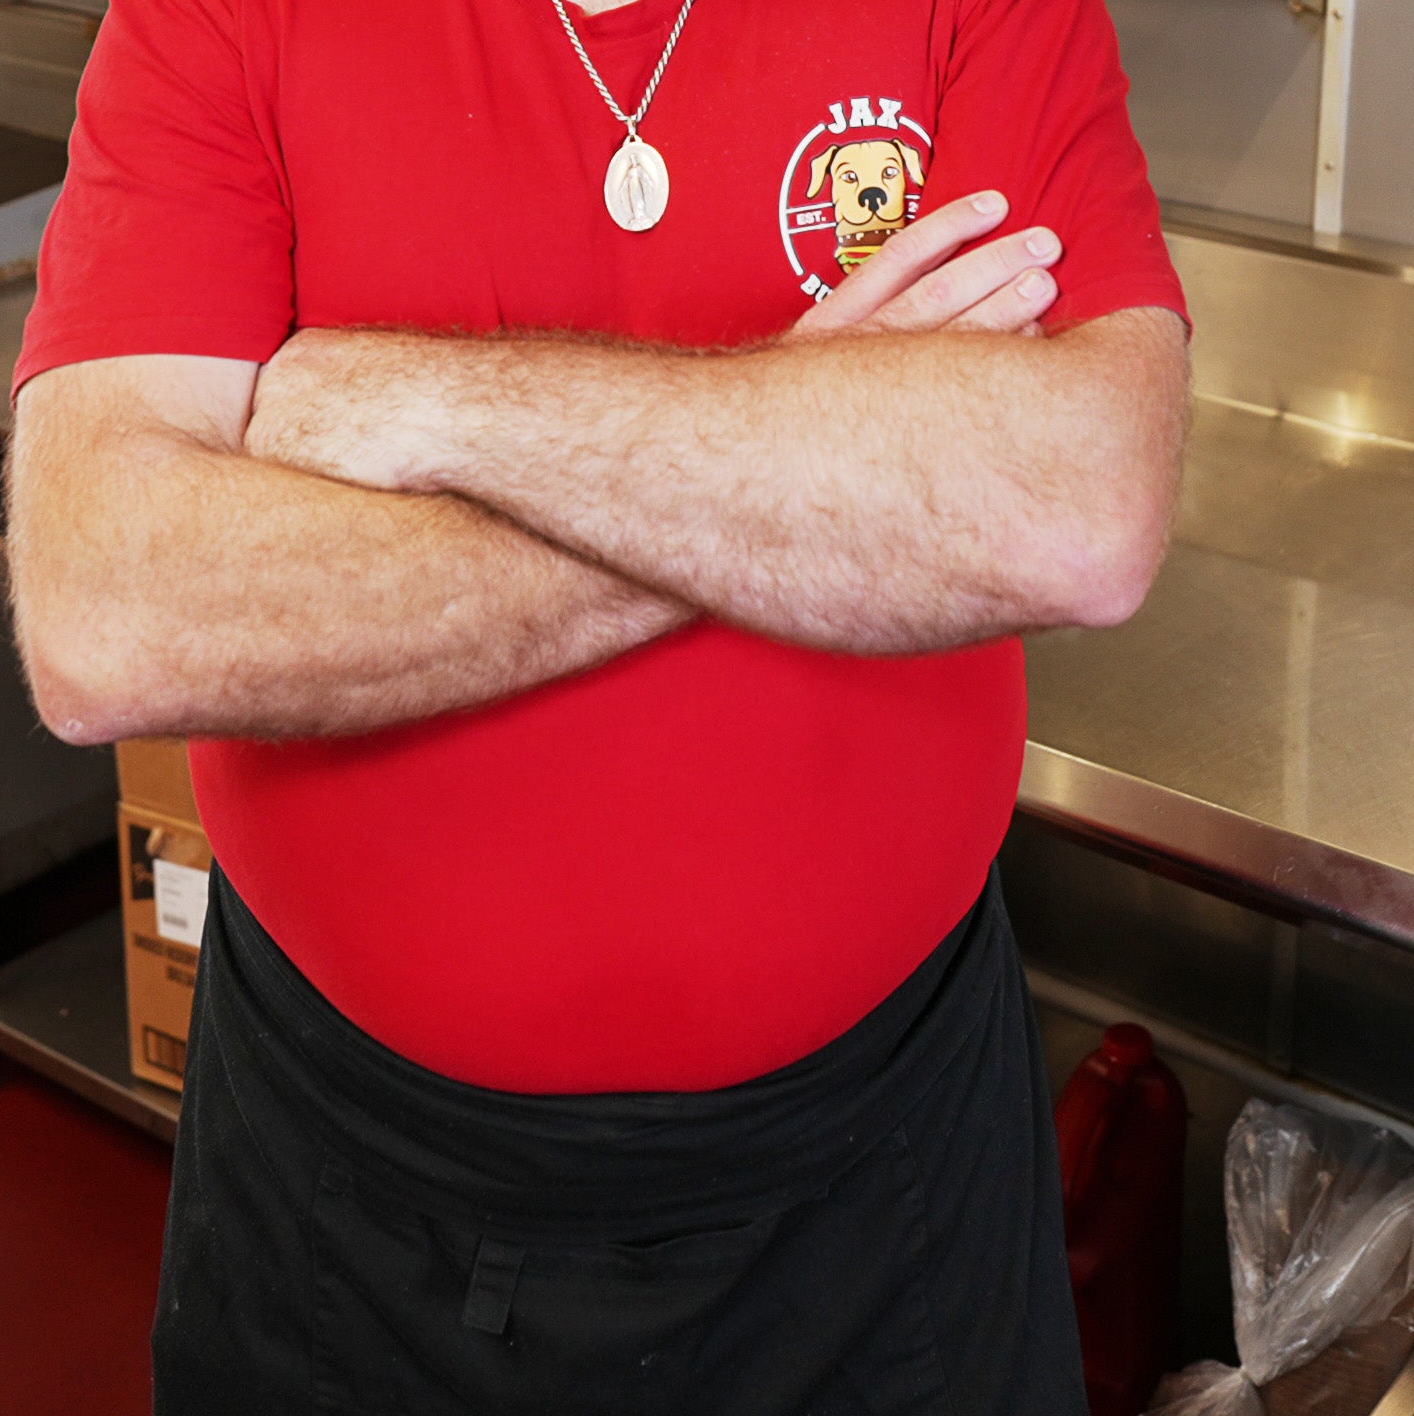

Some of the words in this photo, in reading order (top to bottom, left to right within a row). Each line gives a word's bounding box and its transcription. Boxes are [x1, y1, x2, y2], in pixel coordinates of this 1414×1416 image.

[827, 97, 903, 135] JAX
[795, 210, 827, 226] EST.
[799, 273, 834, 303] BU
